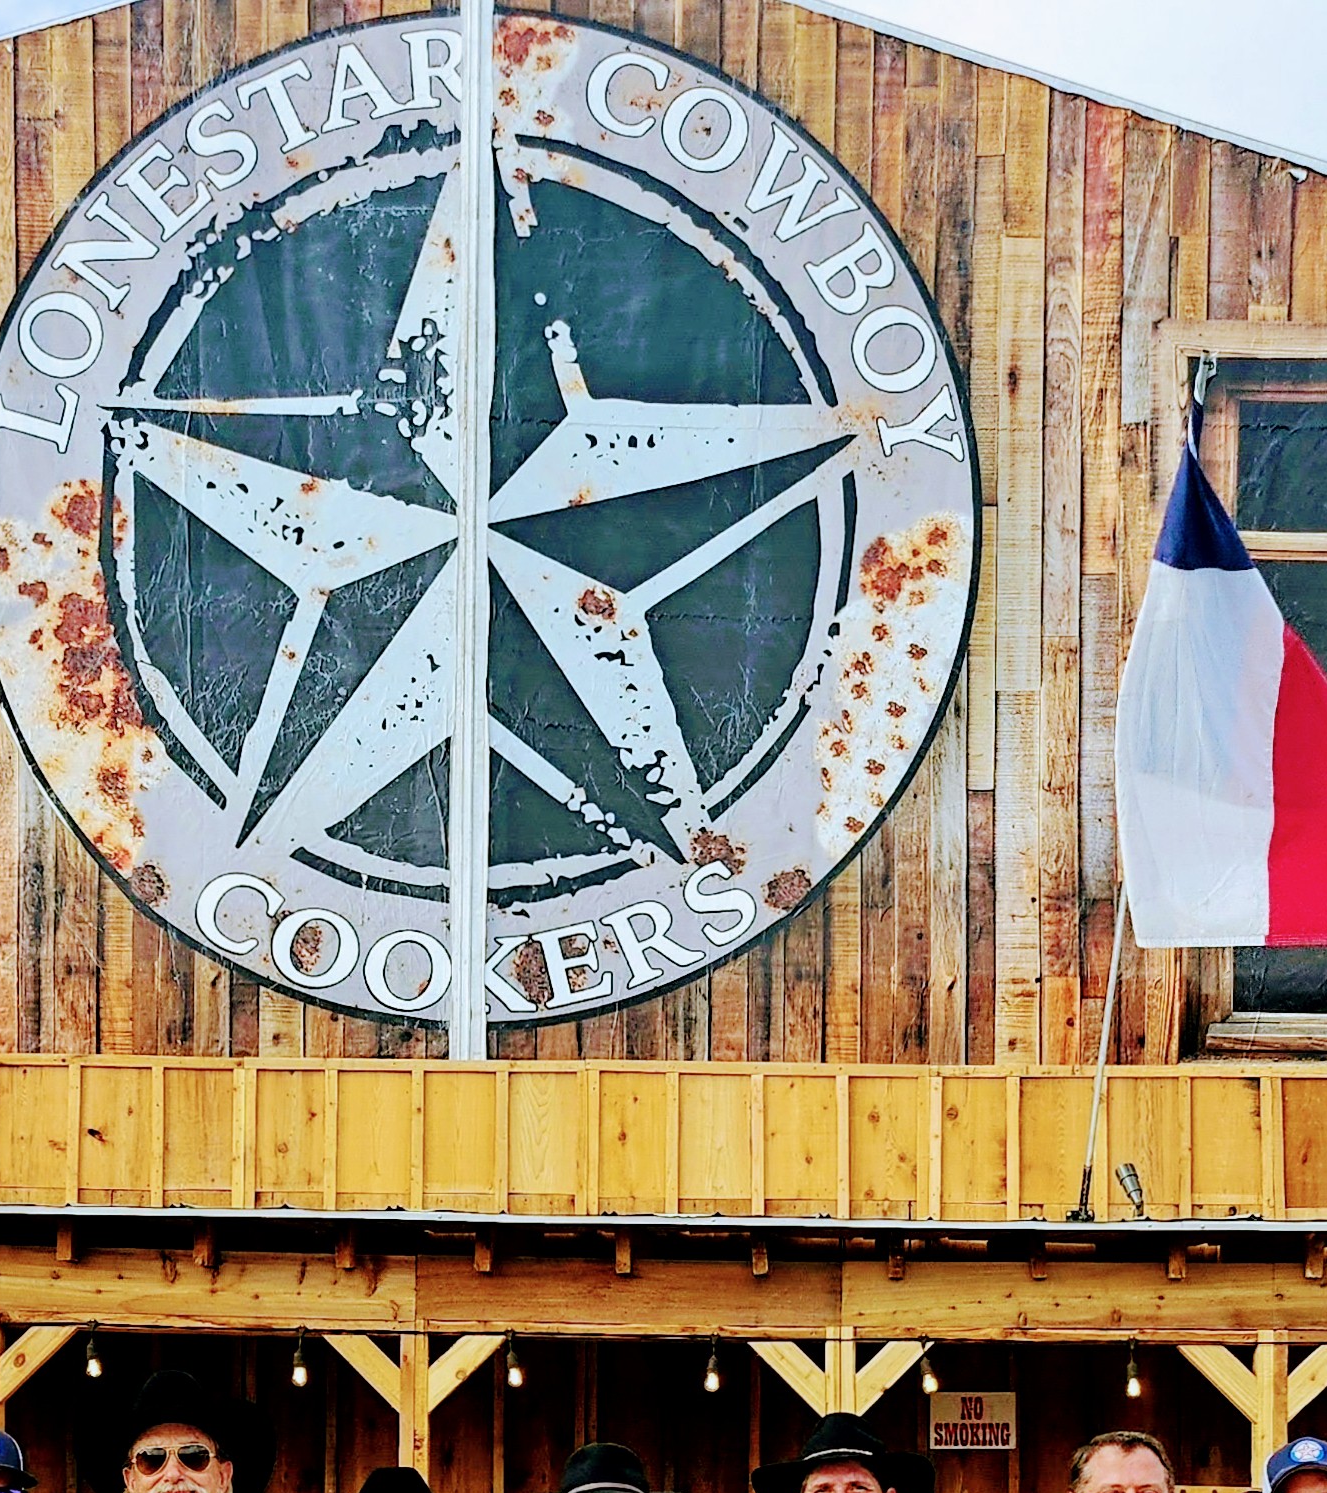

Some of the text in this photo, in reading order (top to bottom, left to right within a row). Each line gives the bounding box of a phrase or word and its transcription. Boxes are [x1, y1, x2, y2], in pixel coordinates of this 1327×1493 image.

[586, 52, 965, 462] COWBOY
[194, 859, 758, 1014] COOKERS
[934, 1422, 1011, 1446] SMOKING
[960, 1396, 984, 1420] NO
